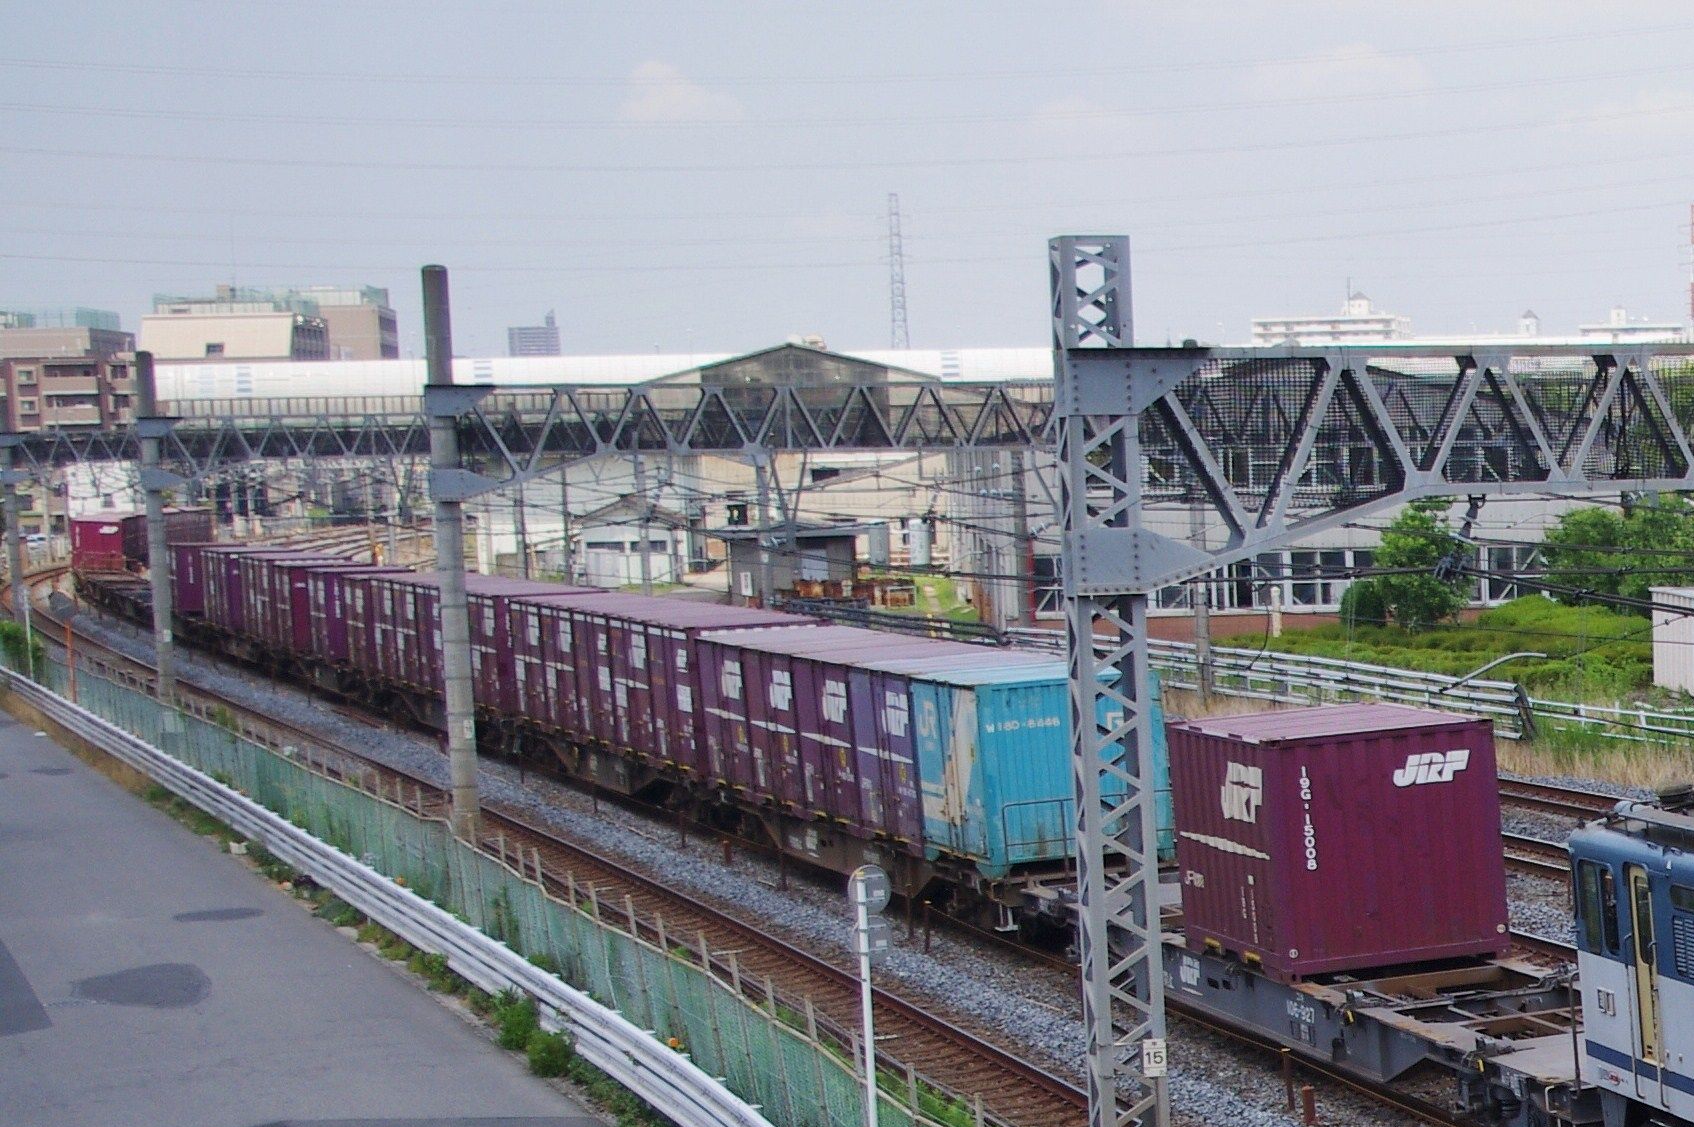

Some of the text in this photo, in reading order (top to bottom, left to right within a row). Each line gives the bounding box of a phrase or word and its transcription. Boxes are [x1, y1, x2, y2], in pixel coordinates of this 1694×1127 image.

[1393, 748, 1471, 788] JRF
[1220, 760, 1263, 824] JRF
[1145, 1050, 1164, 1066] 15
